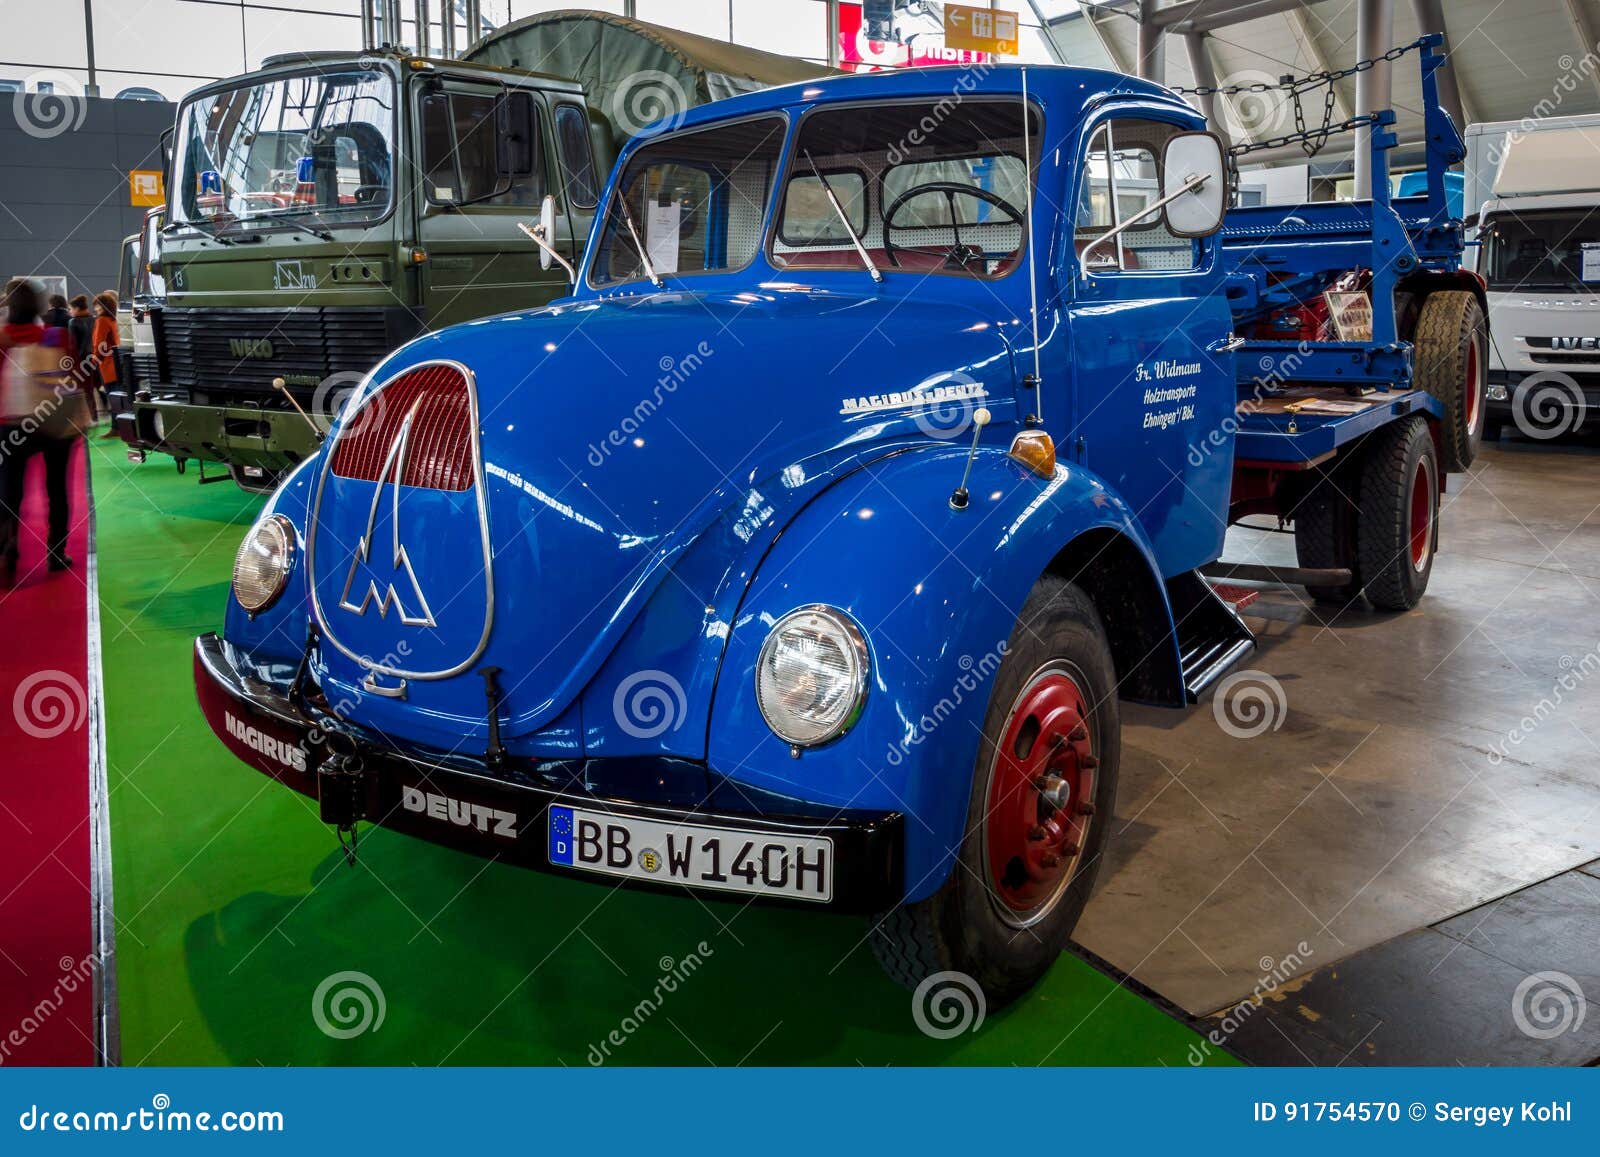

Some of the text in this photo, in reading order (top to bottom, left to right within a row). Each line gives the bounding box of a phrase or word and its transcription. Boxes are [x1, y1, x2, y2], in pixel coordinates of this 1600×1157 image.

[1551, 337, 1600, 351] IVE
[1135, 360, 1201, 382] Fr. Widmann
[1143, 384, 1197, 405] Holztransporte
[225, 711, 307, 773] MAGIRUS
[402, 785, 517, 838] DEUTZ
[557, 841, 566, 854] D
[578, 820, 633, 869] BB
